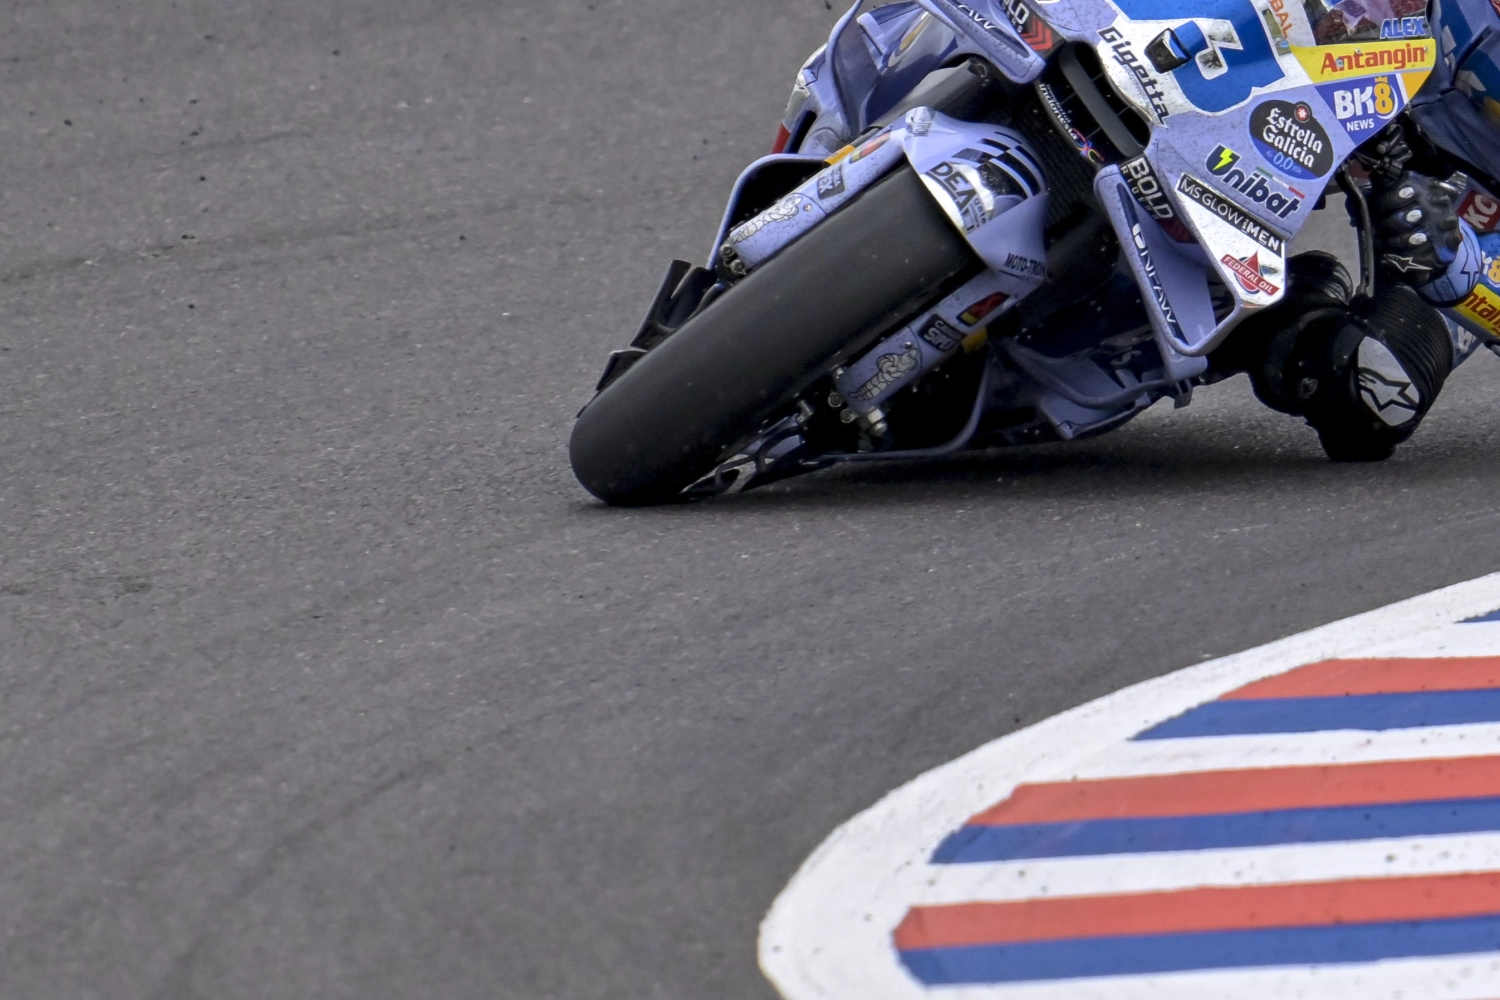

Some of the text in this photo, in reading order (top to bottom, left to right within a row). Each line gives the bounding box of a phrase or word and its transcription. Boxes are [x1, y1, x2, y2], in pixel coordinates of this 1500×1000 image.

[1379, 16, 1427, 39] ALEX
[1101, 26, 1170, 127] Gigetta
[1320, 43, 1427, 75] Antangin
[1039, 83, 1079, 140] indonesia
[1333, 76, 1399, 120] BK8
[1262, 125, 1316, 168] Galicia
[1265, 107, 1323, 154] Estrella
[1346, 119, 1375, 132] NEWS
[1205, 143, 1301, 220] Unibat
[1272, 152, 1294, 170] 0,0
[1127, 158, 1174, 219] BOLD
[1181, 178, 1202, 199] MS
[1201, 191, 1243, 225] GLOW
[1224, 255, 1274, 294] FEDERAL OIL
